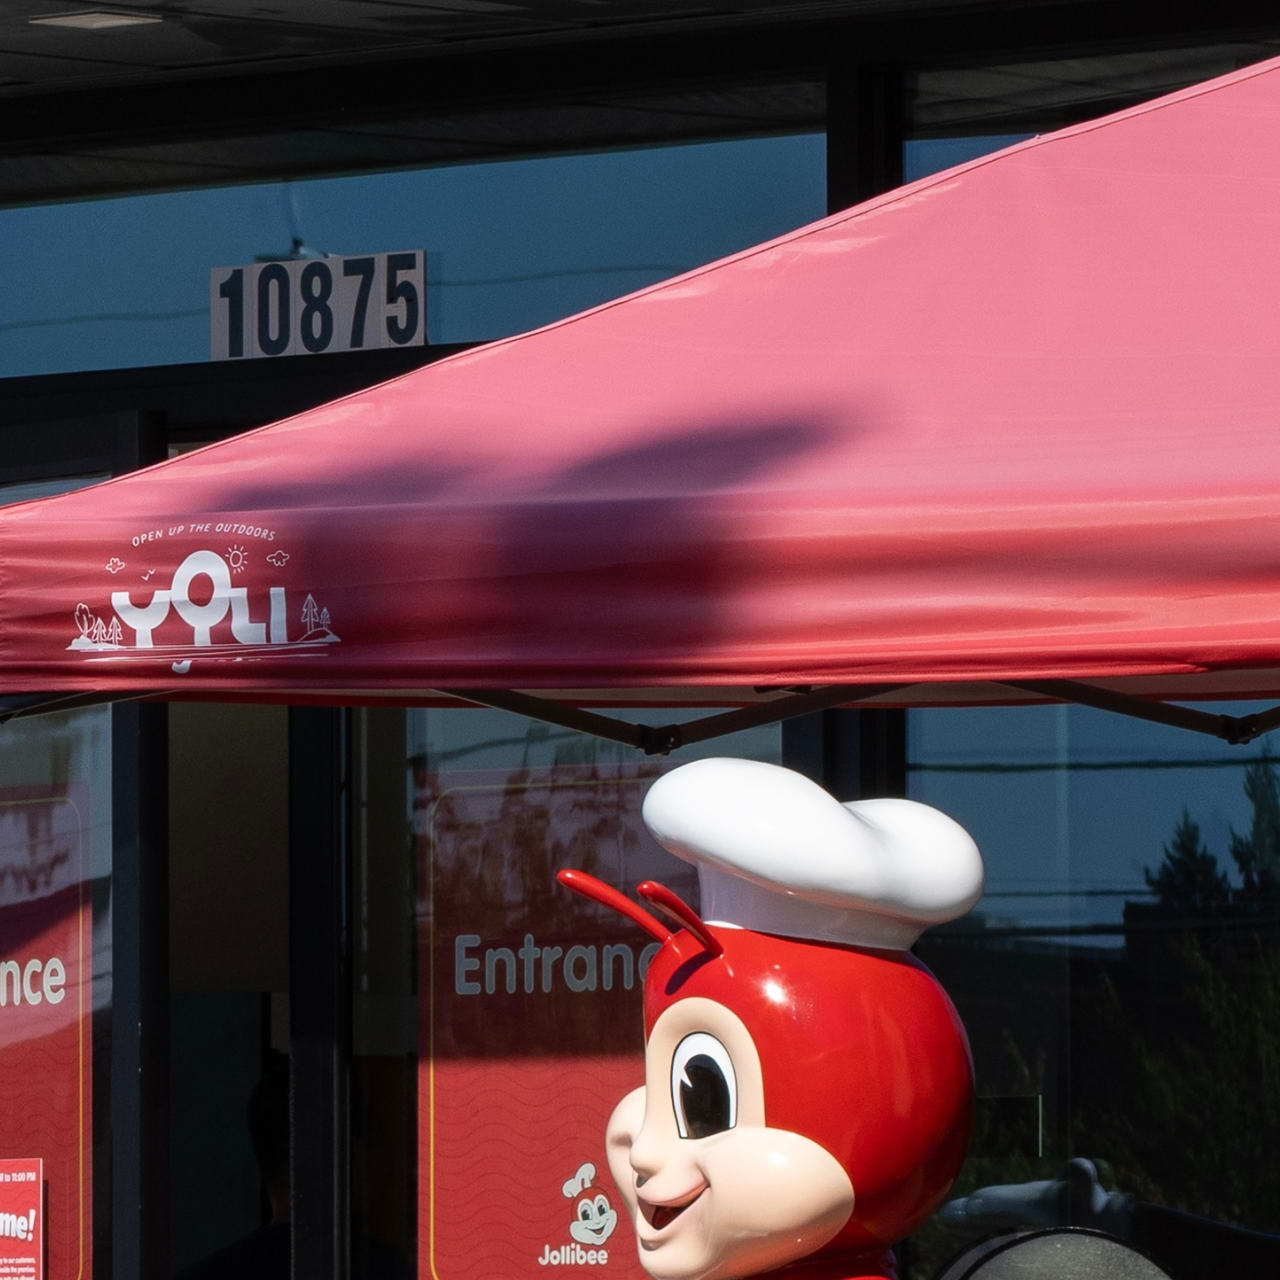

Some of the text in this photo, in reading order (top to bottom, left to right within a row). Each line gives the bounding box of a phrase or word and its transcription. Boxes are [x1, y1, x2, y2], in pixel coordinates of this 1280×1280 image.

[218, 252, 419, 358] 10875
[131, 522, 277, 547] OPEN UP THE OUTDOORS
[454, 933, 660, 996] Entran
[5, 1173, 11, 1182] to
[12, 1172, 26, 1182] 11:00
[26, 1171, 36, 1182] PM
[537, 1243, 608, 1266] Jollibee
